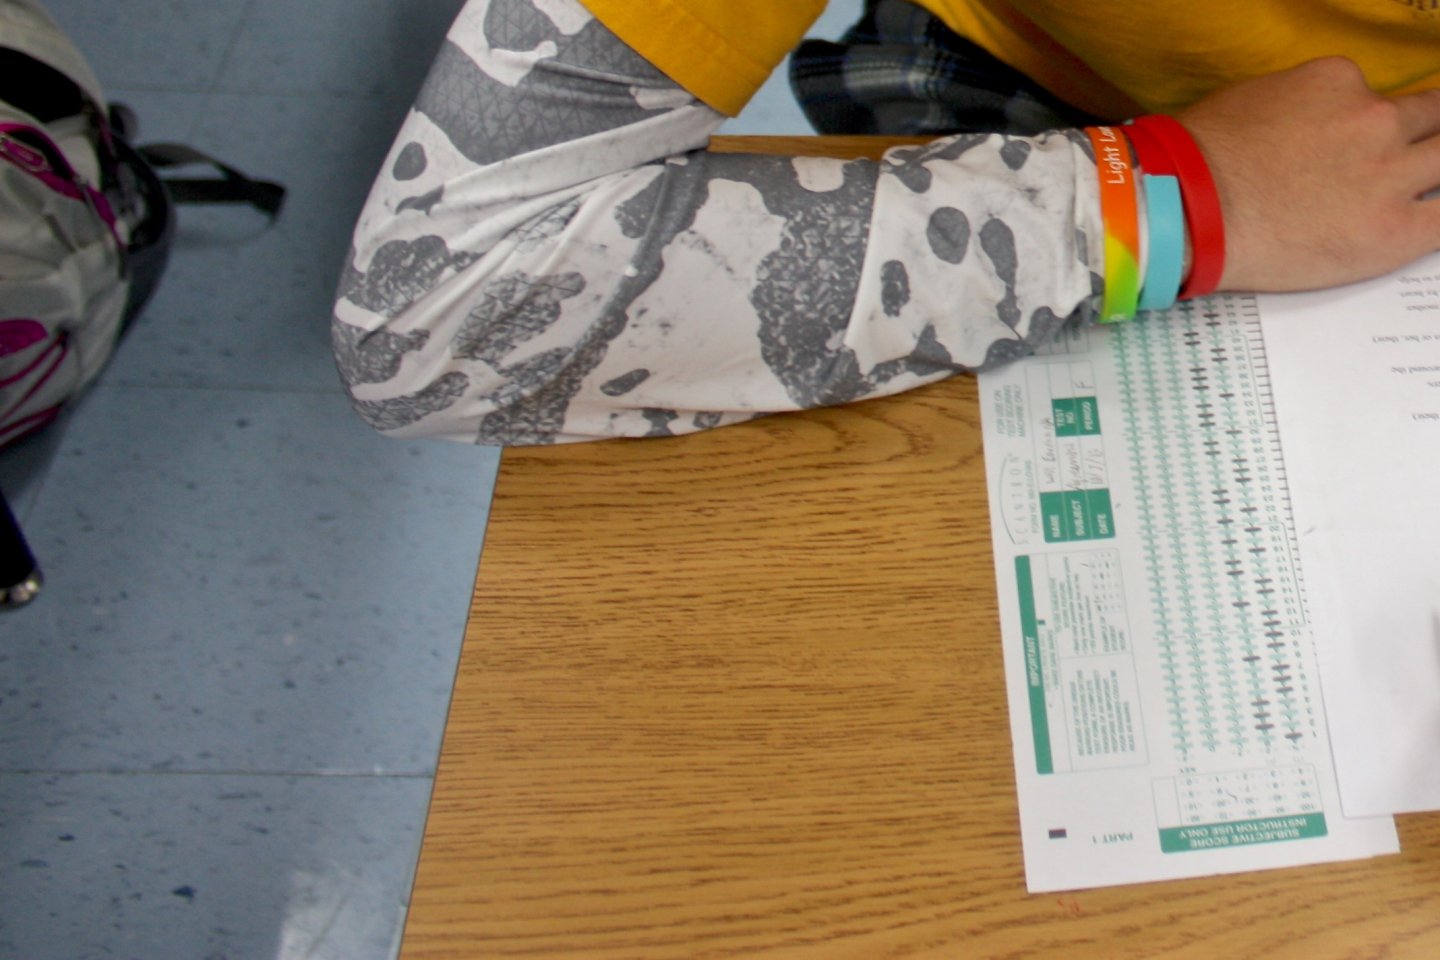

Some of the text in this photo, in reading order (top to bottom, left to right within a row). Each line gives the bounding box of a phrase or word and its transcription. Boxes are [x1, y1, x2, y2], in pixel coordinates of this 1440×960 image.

[1103, 146, 1128, 184] Light
[1054, 407, 1064, 427] TEST
[1081, 400, 1093, 430] PERIOD
[1049, 513, 1060, 538] NAME
[1072, 499, 1085, 536] SUBJECT
[1096, 512, 1108, 534] DATE
[1025, 634, 1040, 687] IMPORTANT
[1100, 830, 1133, 843] PART
[1178, 816, 1306, 839] INSTRUCTOR USE ONLY
[1189, 827, 1300, 848] SUBJECTIVE SCORE
